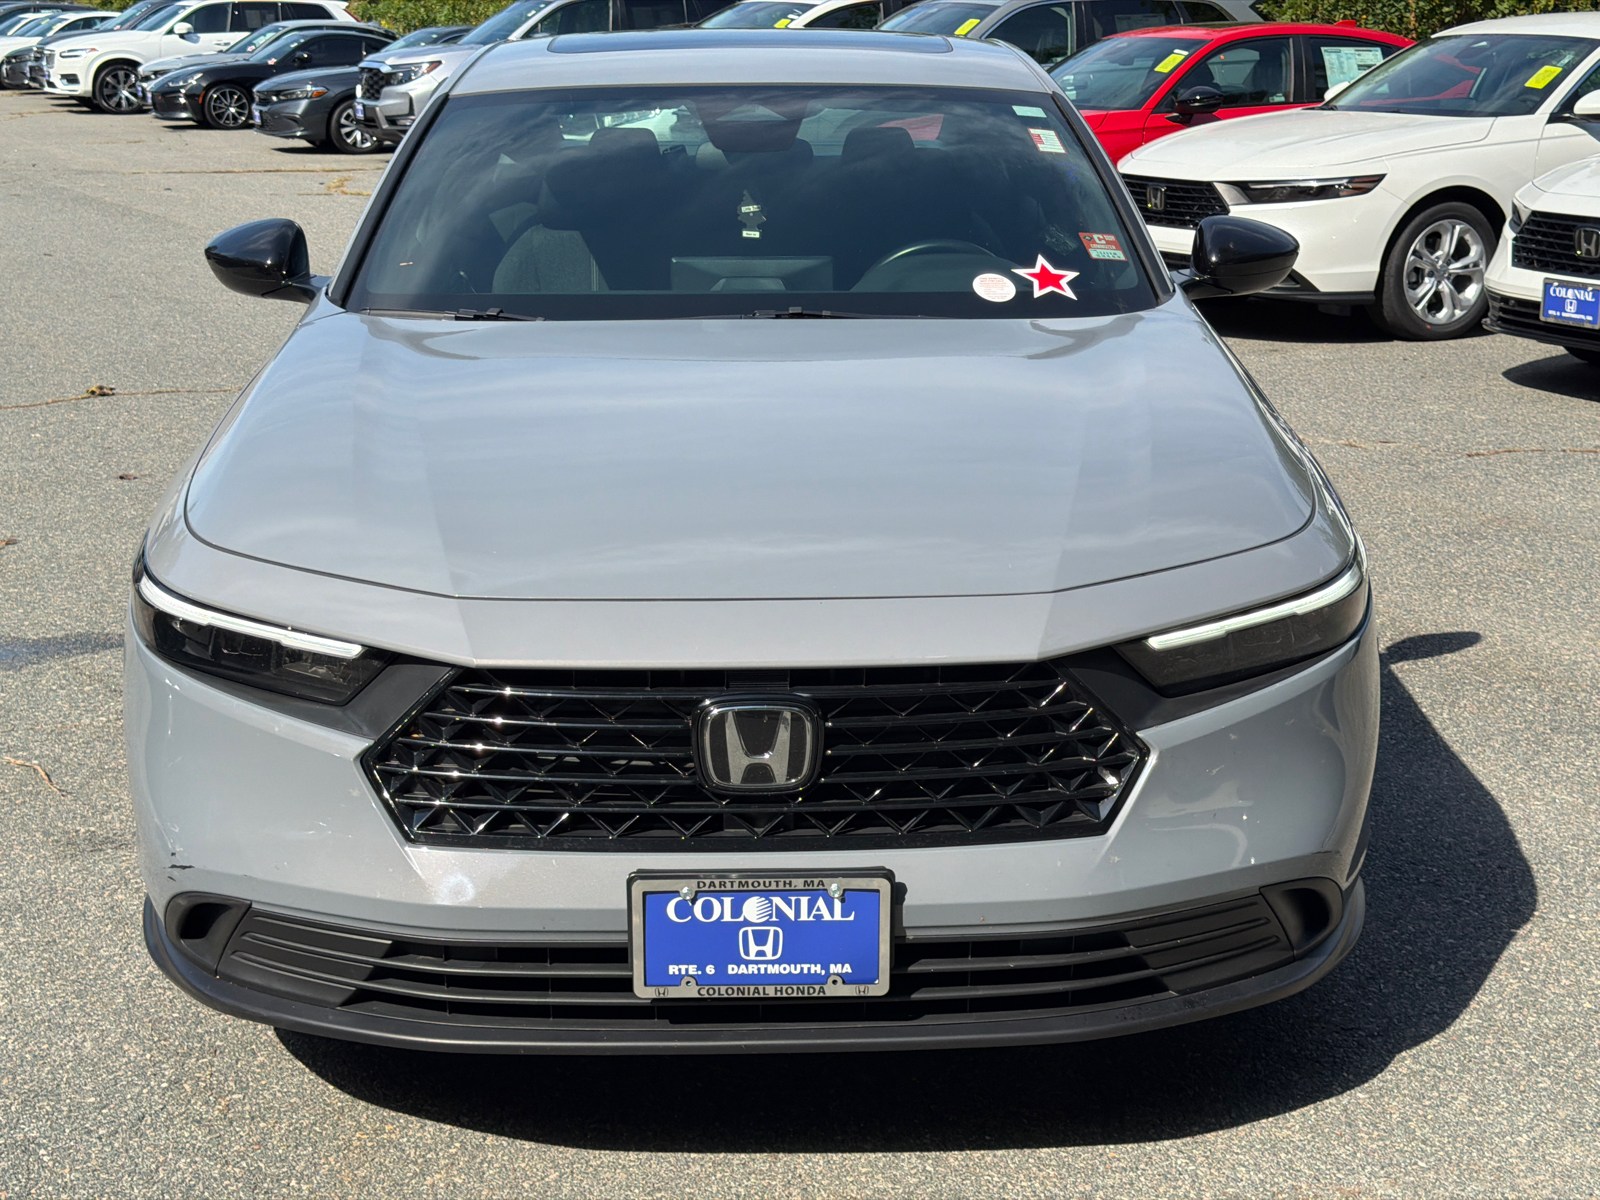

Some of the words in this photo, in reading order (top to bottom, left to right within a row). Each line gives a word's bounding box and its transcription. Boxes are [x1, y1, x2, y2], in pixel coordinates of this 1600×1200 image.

[1550, 286, 1595, 302] COLONIAL
[803, 879, 826, 888] MA
[666, 896, 855, 923] COLONIAL
[668, 964, 702, 975] RTE.
[705, 964, 716, 975] 6
[727, 964, 826, 975] DARTMOUTH,
[829, 963, 852, 974] MA
[697, 986, 770, 997] COLONIAL
[774, 986, 826, 996] HONDA
